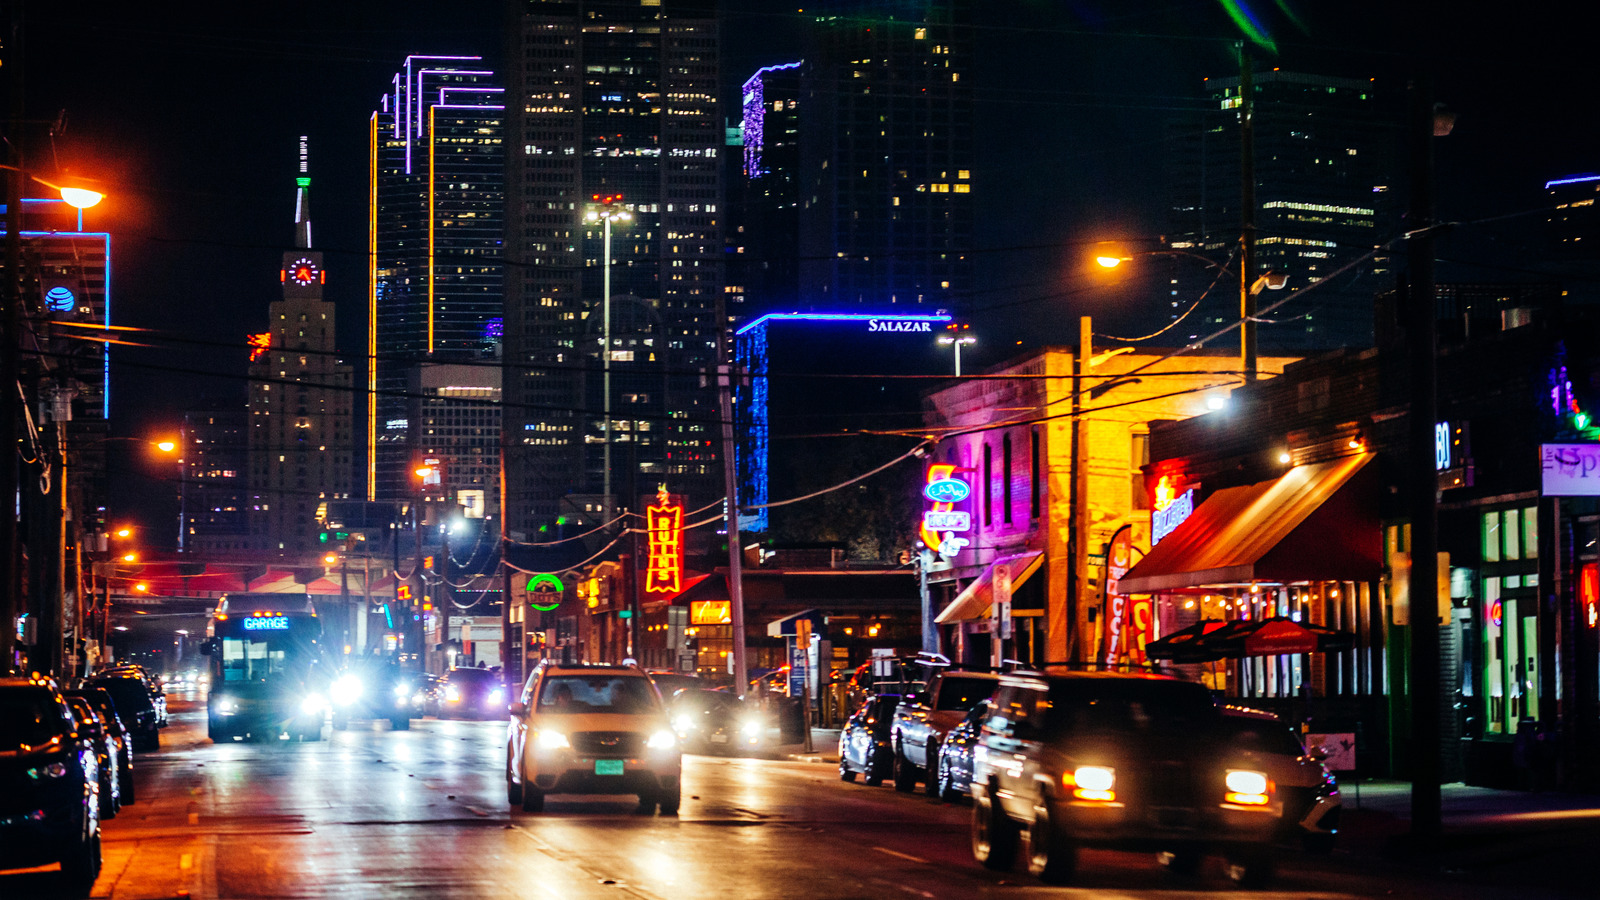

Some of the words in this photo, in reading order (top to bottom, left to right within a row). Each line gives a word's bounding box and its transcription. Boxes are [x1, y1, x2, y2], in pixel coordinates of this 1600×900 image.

[868, 319, 932, 332] SALAZAR
[658, 517, 671, 580] RUINS
[244, 616, 289, 630] GARAGE
